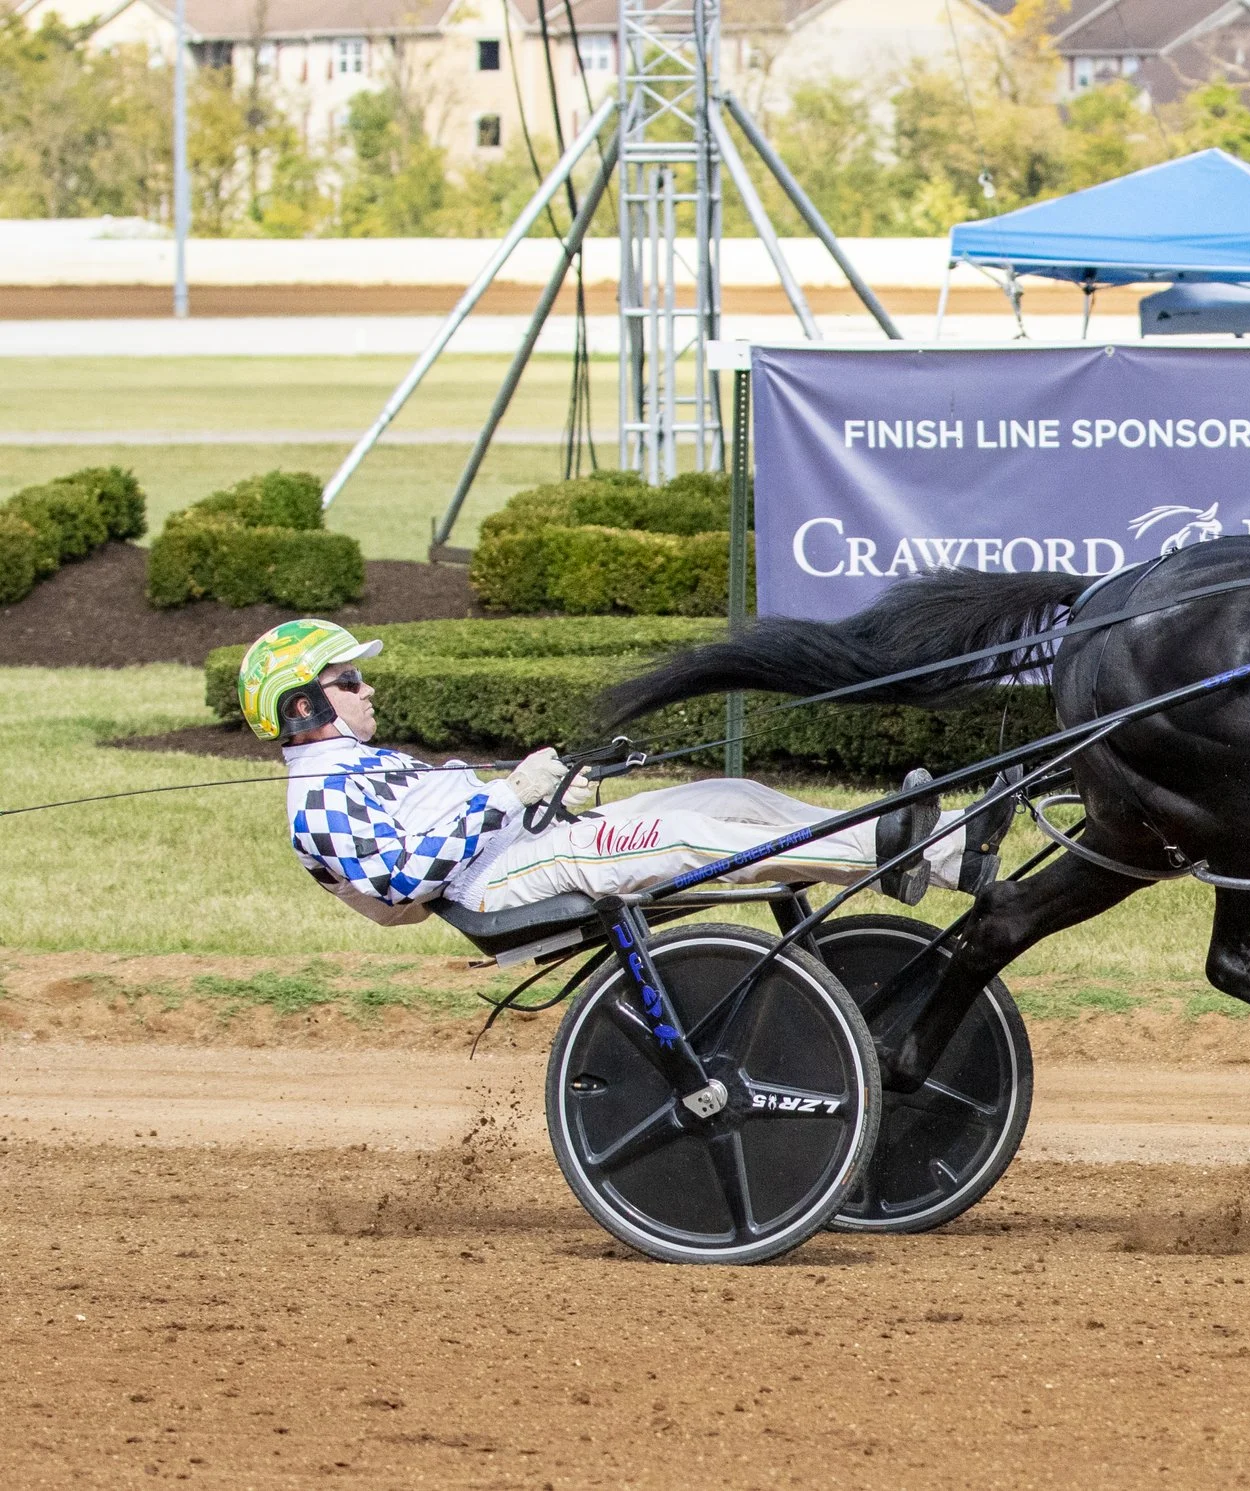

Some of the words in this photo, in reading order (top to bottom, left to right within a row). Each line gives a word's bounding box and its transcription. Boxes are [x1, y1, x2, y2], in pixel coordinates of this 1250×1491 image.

[844, 419, 964, 449] FINISH
[976, 419, 1061, 449] LINE
[792, 516, 1125, 577] CRAWFORD
[569, 816, 662, 857] Walsh
[673, 858, 730, 888] DIAMOND
[734, 841, 777, 865] CREEK
[778, 827, 813, 849] FARM
[778, 1096, 841, 1114] LZR
